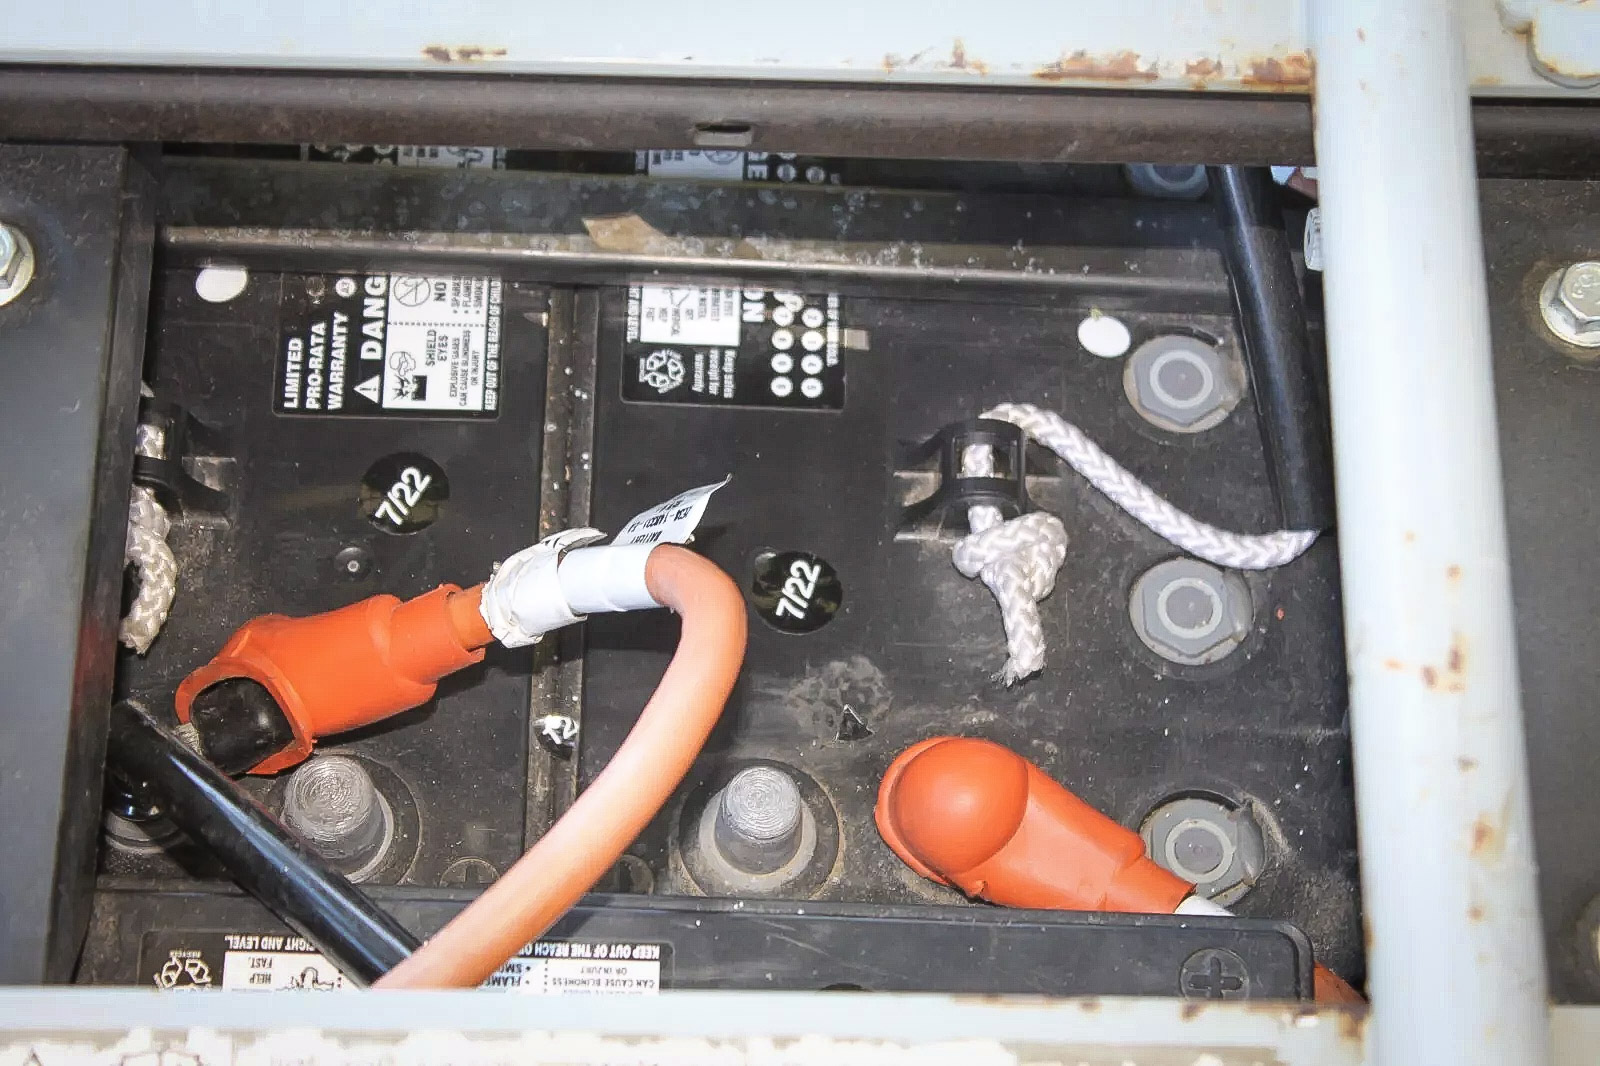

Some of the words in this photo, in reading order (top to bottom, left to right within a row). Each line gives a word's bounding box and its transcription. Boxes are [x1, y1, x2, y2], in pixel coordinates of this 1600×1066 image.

[433, 282, 447, 302] NO
[489, 304, 500, 316] OF
[488, 316, 500, 342] REACH
[425, 329, 437, 366] SHIELD
[437, 335, 449, 362] EYES
[487, 343, 499, 359] THE
[305, 321, 327, 410] PRO-RATA
[327, 311, 349, 410] WARRANTY
[471, 350, 480, 375] INJURY
[486, 359, 498, 371] OF
[707, 349, 719, 380] receipt
[723, 350, 735, 372] Keep
[284, 337, 304, 409] LIMITED
[450, 361, 459, 397] EXPLOSIVE
[460, 368, 469, 391] CAUSE
[471, 376, 478, 386] OR
[485, 372, 497, 388] OUT
[691, 354, 704, 393] warranty
[709, 382, 719, 395] for
[724, 374, 734, 398] sales
[459, 392, 468, 406] CAN
[484, 389, 497, 411] KEEP
[374, 466, 432, 526] 7/22
[775, 560, 820, 619] 7/22
[224, 935, 256, 950] LEVEL.
[260, 936, 282, 950] AND
[535, 942, 570, 958] REACH
[571, 943, 592, 958] THE
[594, 944, 607, 958] OF
[610, 944, 631, 959] OUT
[632, 944, 660, 960] KEEP
[249, 972, 272, 984] HELP
[605, 978, 634, 989] CAUSE
[636, 979, 656, 989] CAN
